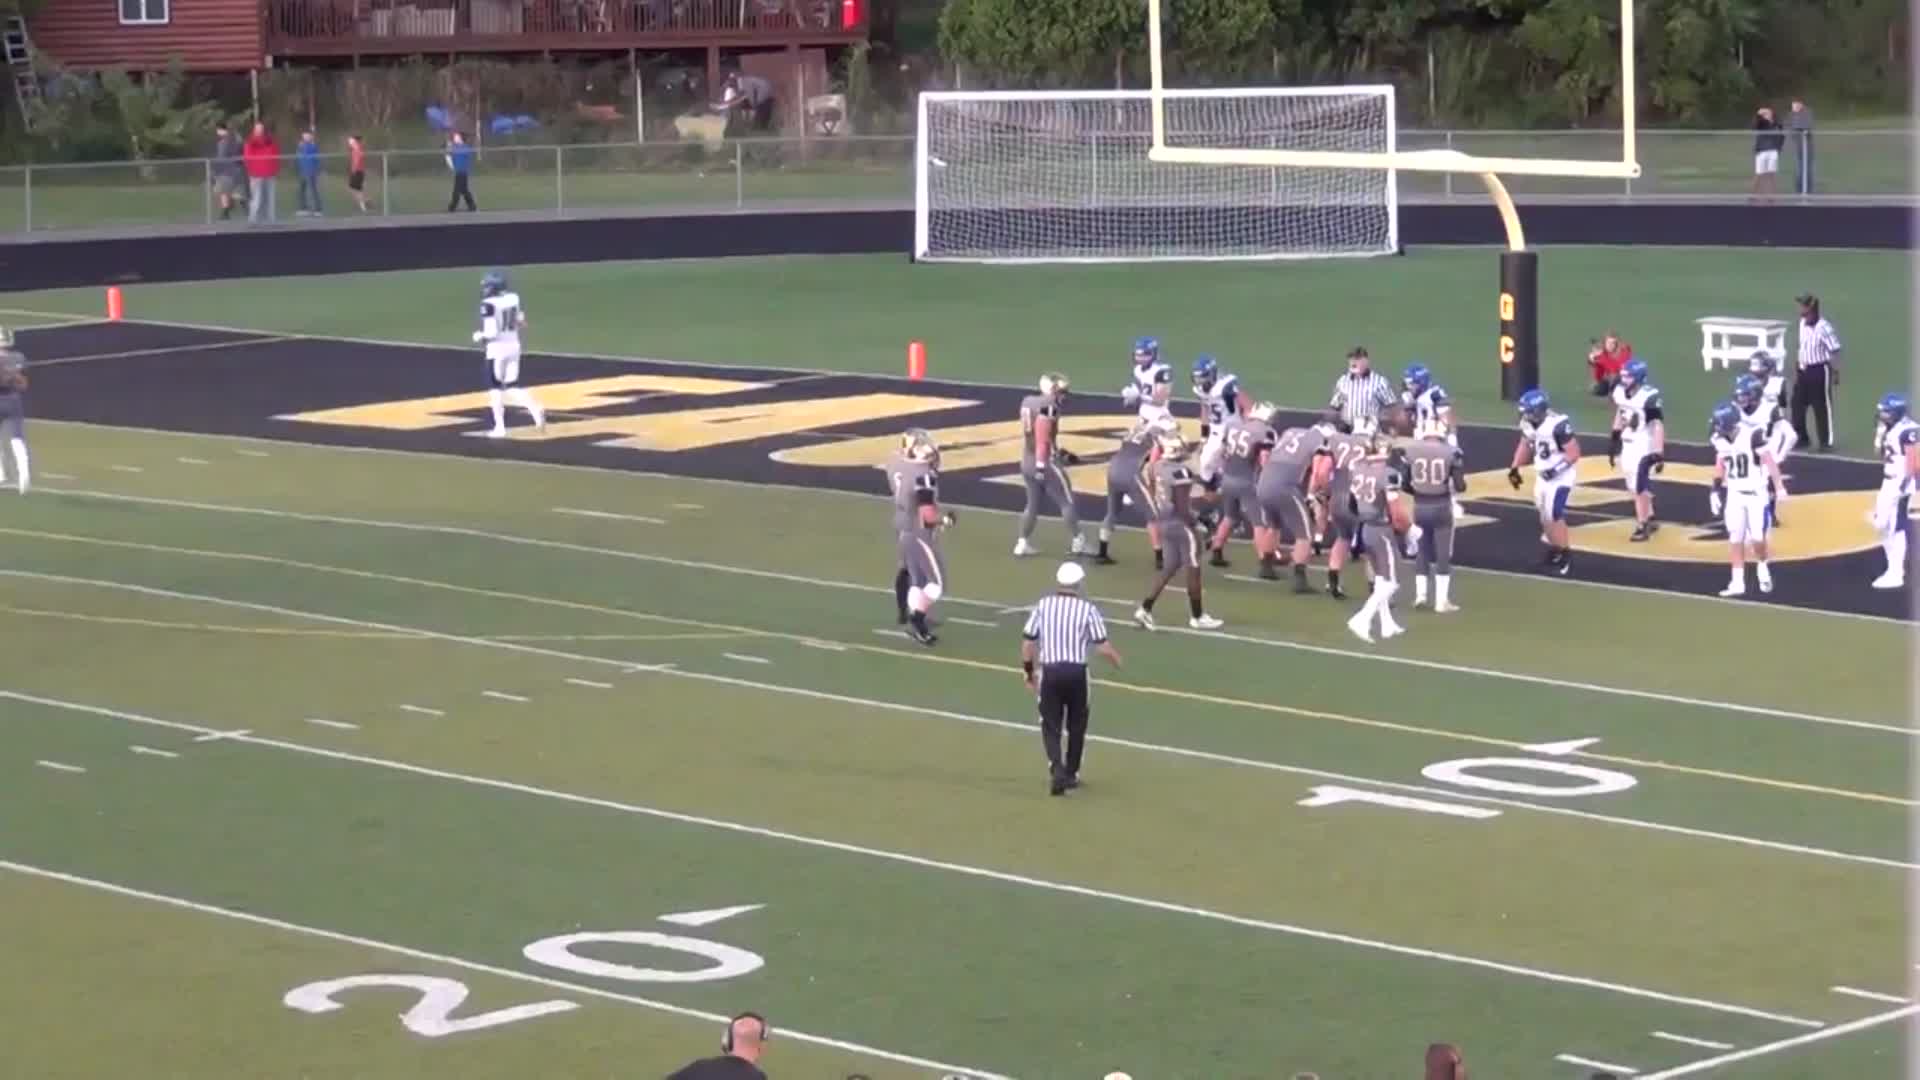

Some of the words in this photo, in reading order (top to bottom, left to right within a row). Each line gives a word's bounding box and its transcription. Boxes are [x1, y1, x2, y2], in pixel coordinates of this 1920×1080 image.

[1500, 335, 1515, 363] C
[1226, 427, 1250, 459] 55
[1336, 441, 1366, 471] 72
[1413, 457, 1446, 486] 30
[1723, 452, 1750, 479] 20
[1349, 473, 1377, 504] 23
[1297, 756, 1639, 818] 10
[283, 930, 766, 1038] 20
